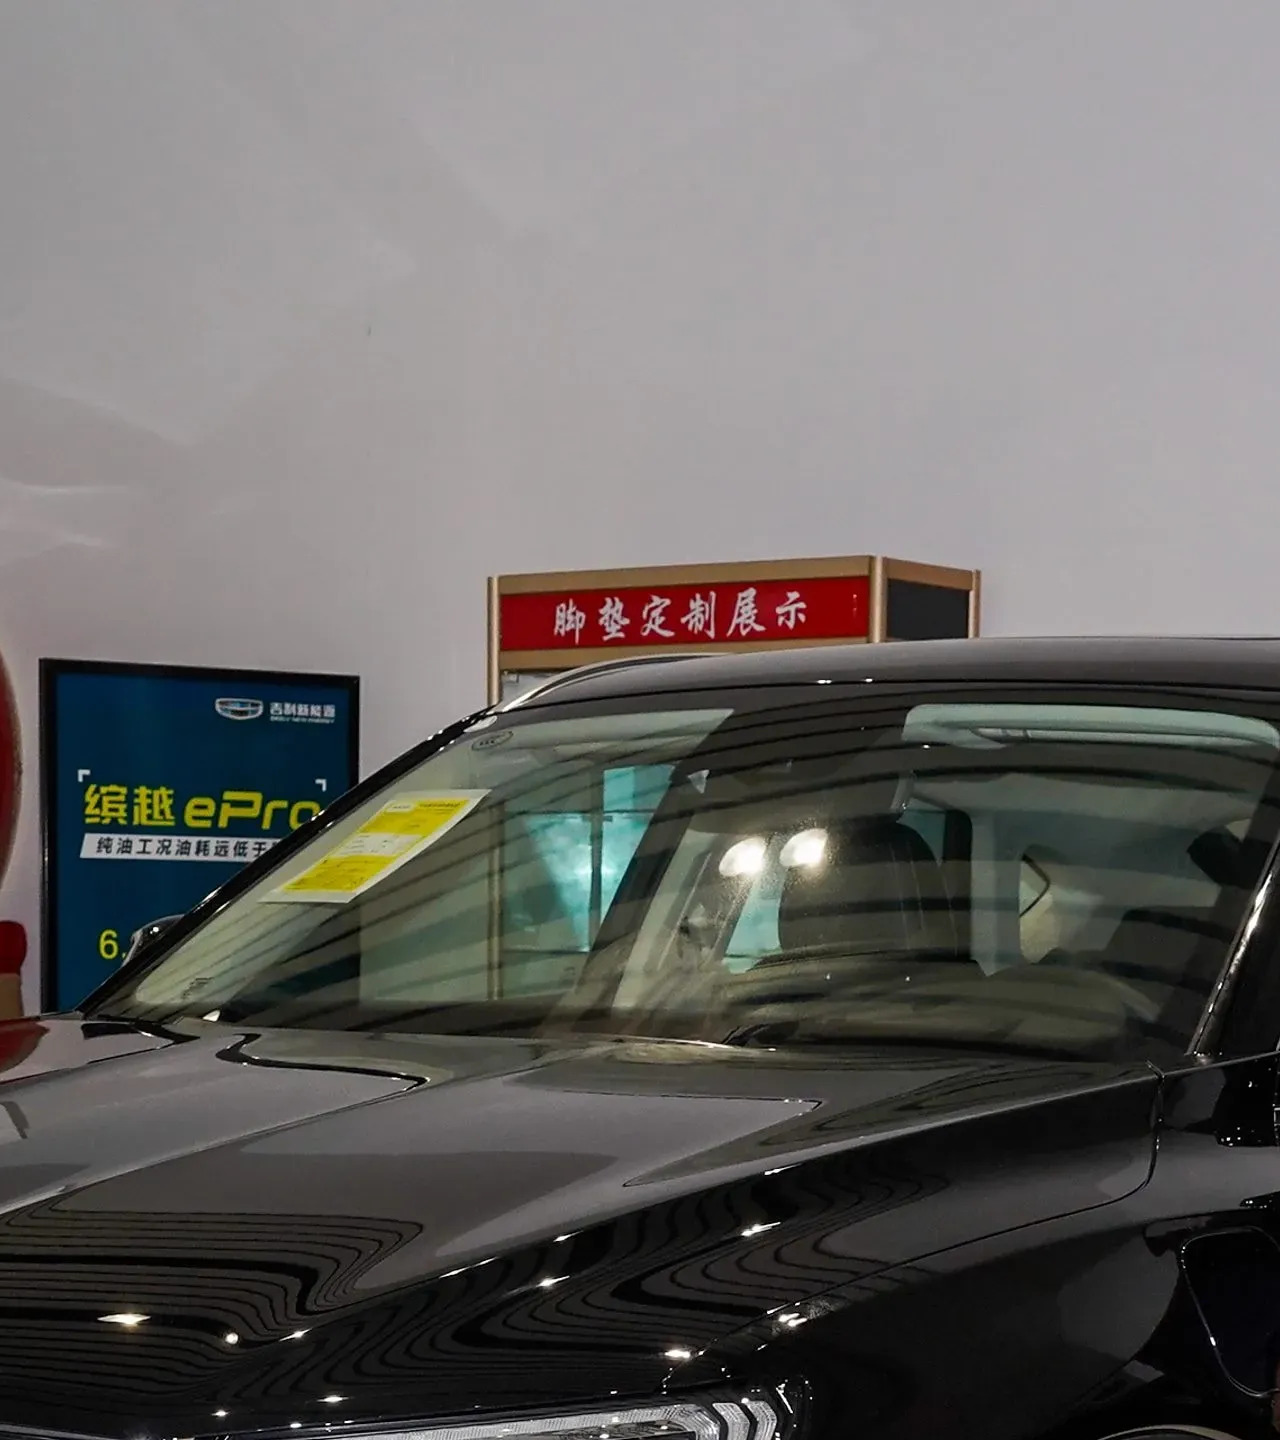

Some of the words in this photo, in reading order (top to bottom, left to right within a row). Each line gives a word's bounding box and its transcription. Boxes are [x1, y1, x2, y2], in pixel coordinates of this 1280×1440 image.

[553, 587, 808, 644] 脚垫定制展示
[96, 835, 278, 858] 纯油工况油耗远低于
